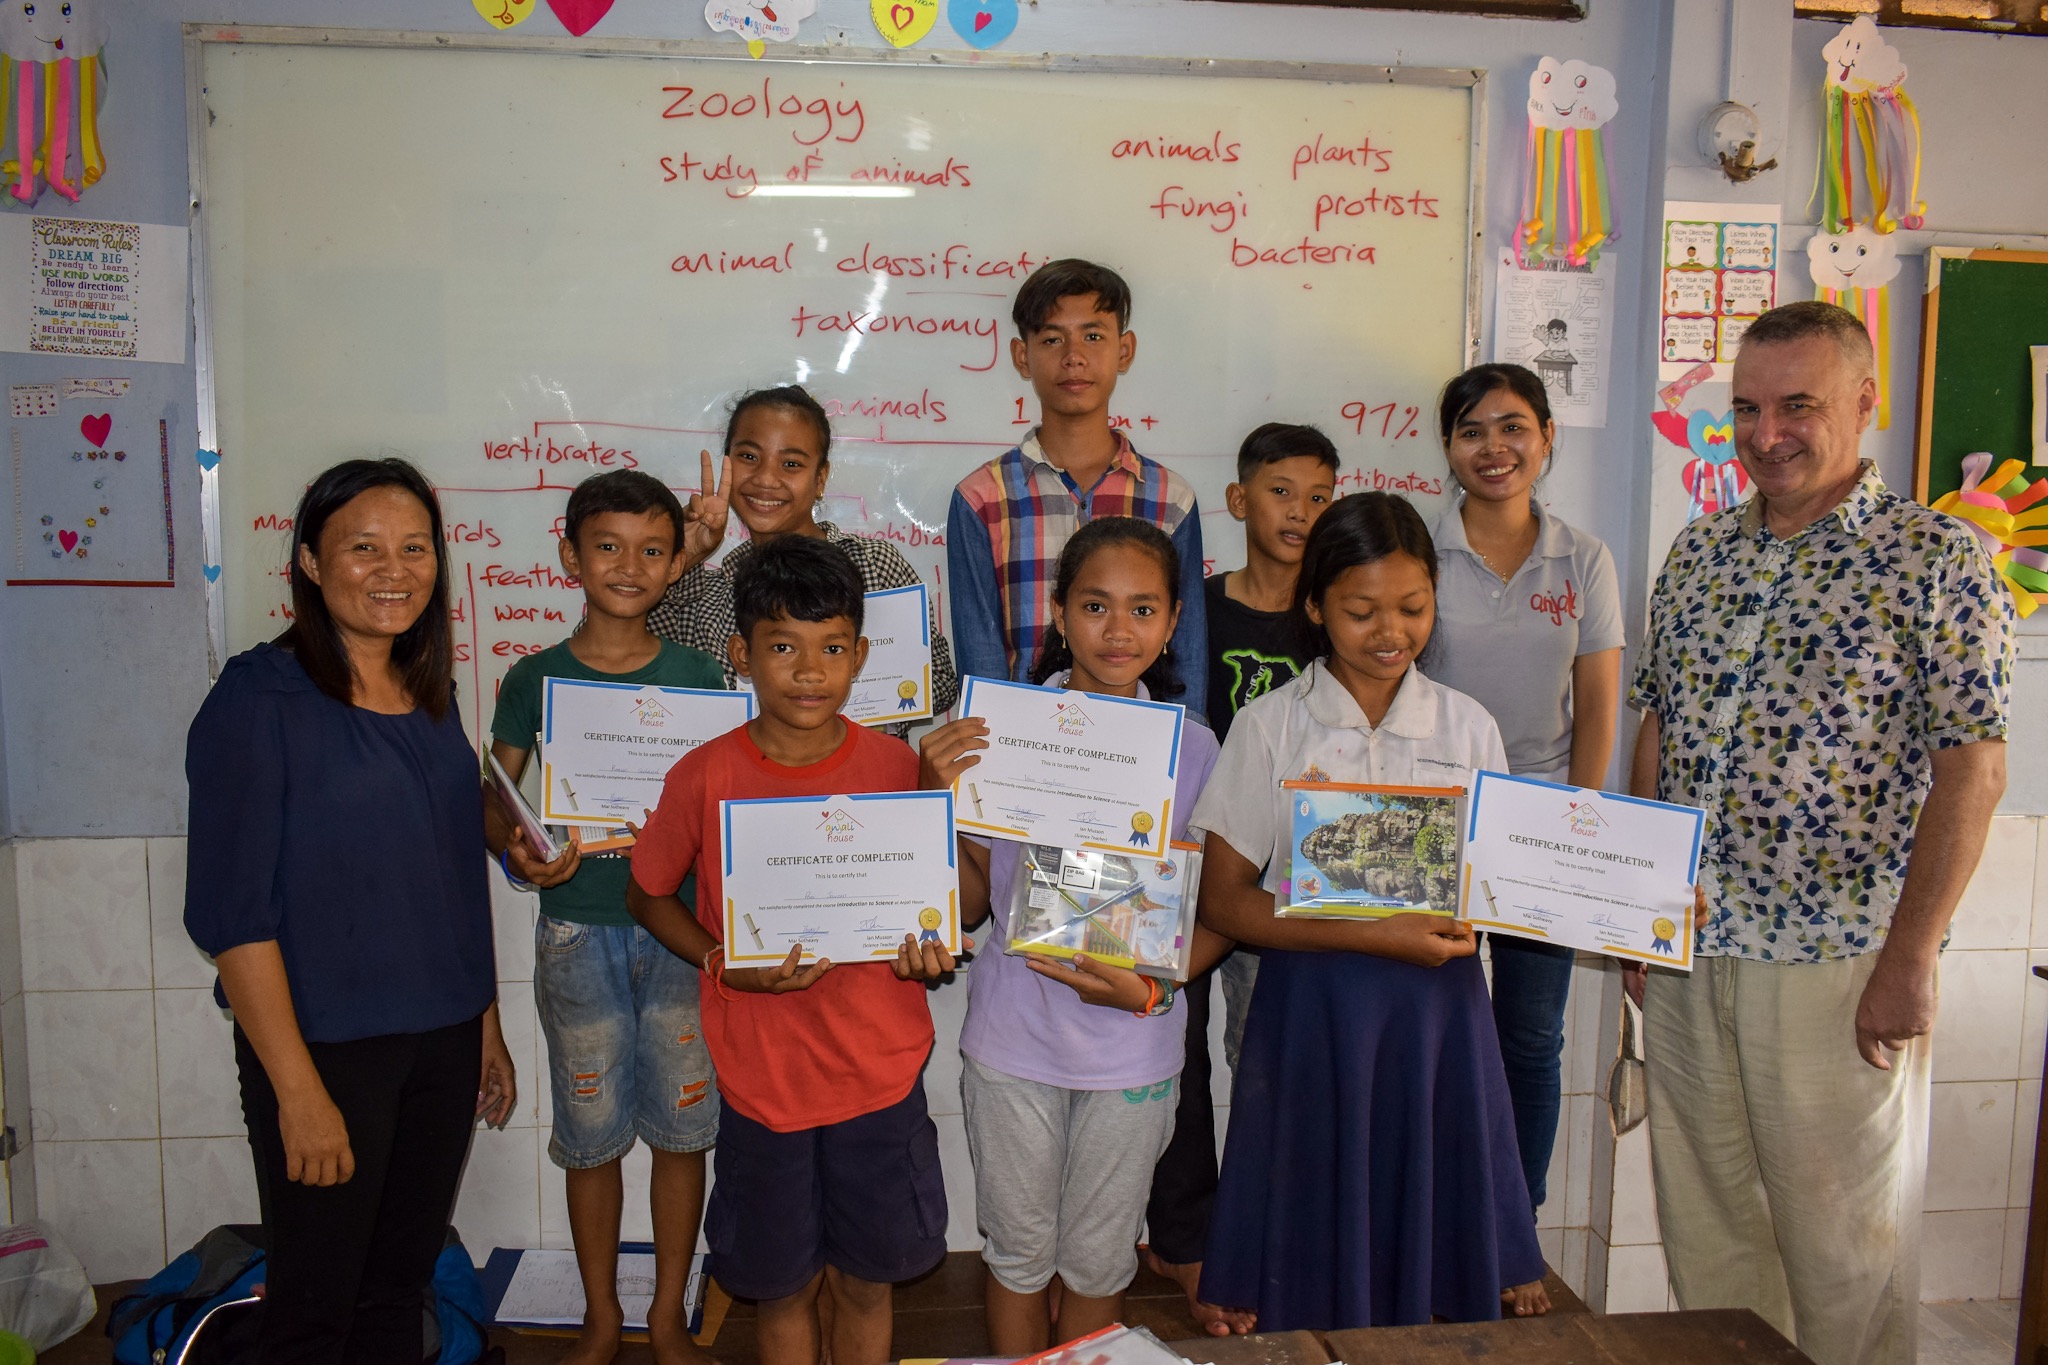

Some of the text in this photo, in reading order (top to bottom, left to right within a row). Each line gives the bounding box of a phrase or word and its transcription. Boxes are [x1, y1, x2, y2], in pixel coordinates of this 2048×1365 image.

[1111, 130, 1393, 181] animals plants
[660, 148, 971, 199] study of animals
[1150, 186, 1440, 233] fungi protists
[38, 227, 133, 252] Classroom Rules
[48, 248, 123, 264] DREAM BIG
[1231, 236, 1376, 268] bacteria
[41, 258, 129, 272] Be ready to learn
[671, 242, 1051, 280] animal classificati
[41, 268, 130, 283] USE KIND WORDS
[46, 278, 124, 292] Follow directions
[41, 288, 130, 301] Always do your best
[54, 299, 116, 311] LISTEN CAREFULLY
[39, 307, 130, 323] Raise your hand to speak
[51, 317, 67, 326] Be
[82, 320, 119, 329] friend
[42, 325, 126, 338] BELIEVE IN YOURSELF
[791, 305, 999, 372] taxonomy
[825, 388, 948, 423] animals
[1340, 401, 1420, 440] 97%
[483, 435, 639, 469] vertibrates
[1335, 467, 1442, 495] ertibrates
[446, 518, 502, 548] irds
[869, 637, 894, 647] ETION
[640, 717, 664, 727] house
[1058, 715, 1086, 727] anjali
[1058, 724, 1084, 736] house
[584, 732, 706, 747] CERTIFICATE OF COMPLET
[998, 736, 1138, 765] CERTIFICATE OF COMPLETION
[1063, 763, 1080, 771] certify
[1056, 790, 1087, 799] Introduction
[1093, 795, 1111, 803] Science
[825, 821, 855, 834] anjali
[1570, 815, 1600, 828] anjali
[827, 830, 854, 843] house
[1570, 823, 1598, 838] house
[766, 852, 915, 866] CERTIFICATE OF COMPLETION
[1508, 834, 1655, 869] CERTIFICATE OF COMPLETION
[1554, 859, 1565, 867] This
[1577, 864, 1595, 873] certify
[838, 872, 855, 880] certify
